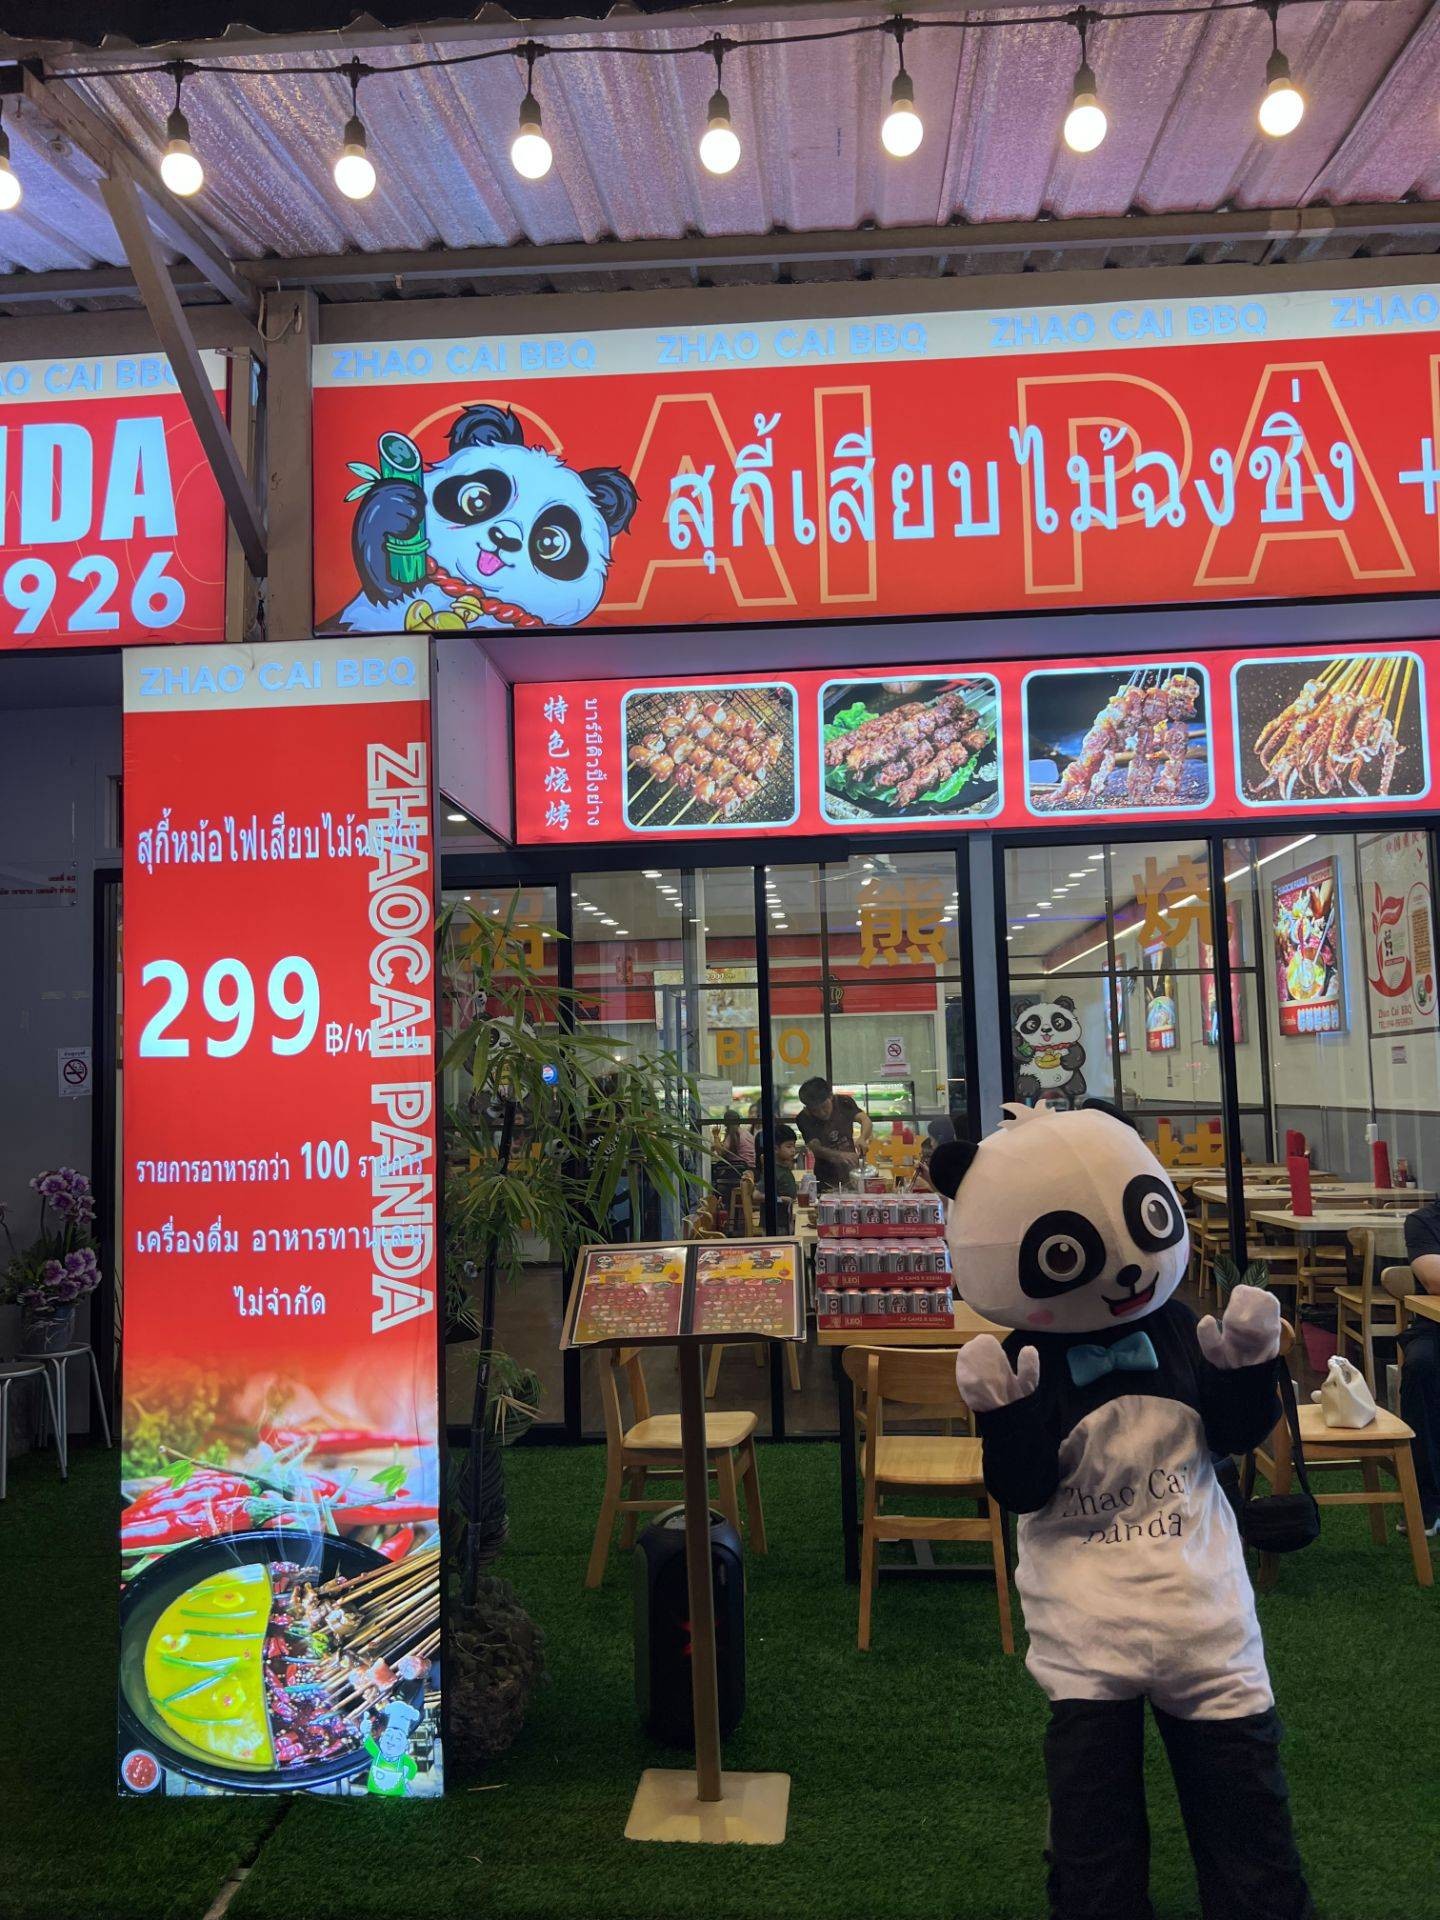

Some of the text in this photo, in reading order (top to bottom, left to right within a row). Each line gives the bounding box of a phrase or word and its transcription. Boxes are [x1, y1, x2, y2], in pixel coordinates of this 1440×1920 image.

[990, 302, 1268, 350] ZHAO CAI BBQ
[1331, 294, 1440, 329] ZHAO
[332, 337, 597, 380] ZHAO CAI BBQ
[657, 322, 929, 365] ZHAO CAI BBQ
[44, 361, 104, 394] CAI
[117, 356, 180, 388] BB
[0, 416, 178, 545] DA
[668, 378, 1356, 574] สุกี้เสียบไม้ฉงชิ่ง
[1016, 353, 1440, 595] PA
[3, 551, 186, 635] 926
[139, 655, 417, 697] ZHAO CAI BBQ
[857, 876, 950, 969] 熊
[139, 955, 320, 1059] 299
[136, 1152, 291, 1183] รายการอาหารกว่า
[300, 1139, 350, 1180] 100
[371, 1081, 434, 1334] PANDA
[136, 1214, 239, 1253] เครื่องดื่ม
[233, 1284, 327, 1316] ไม่จำกัด
